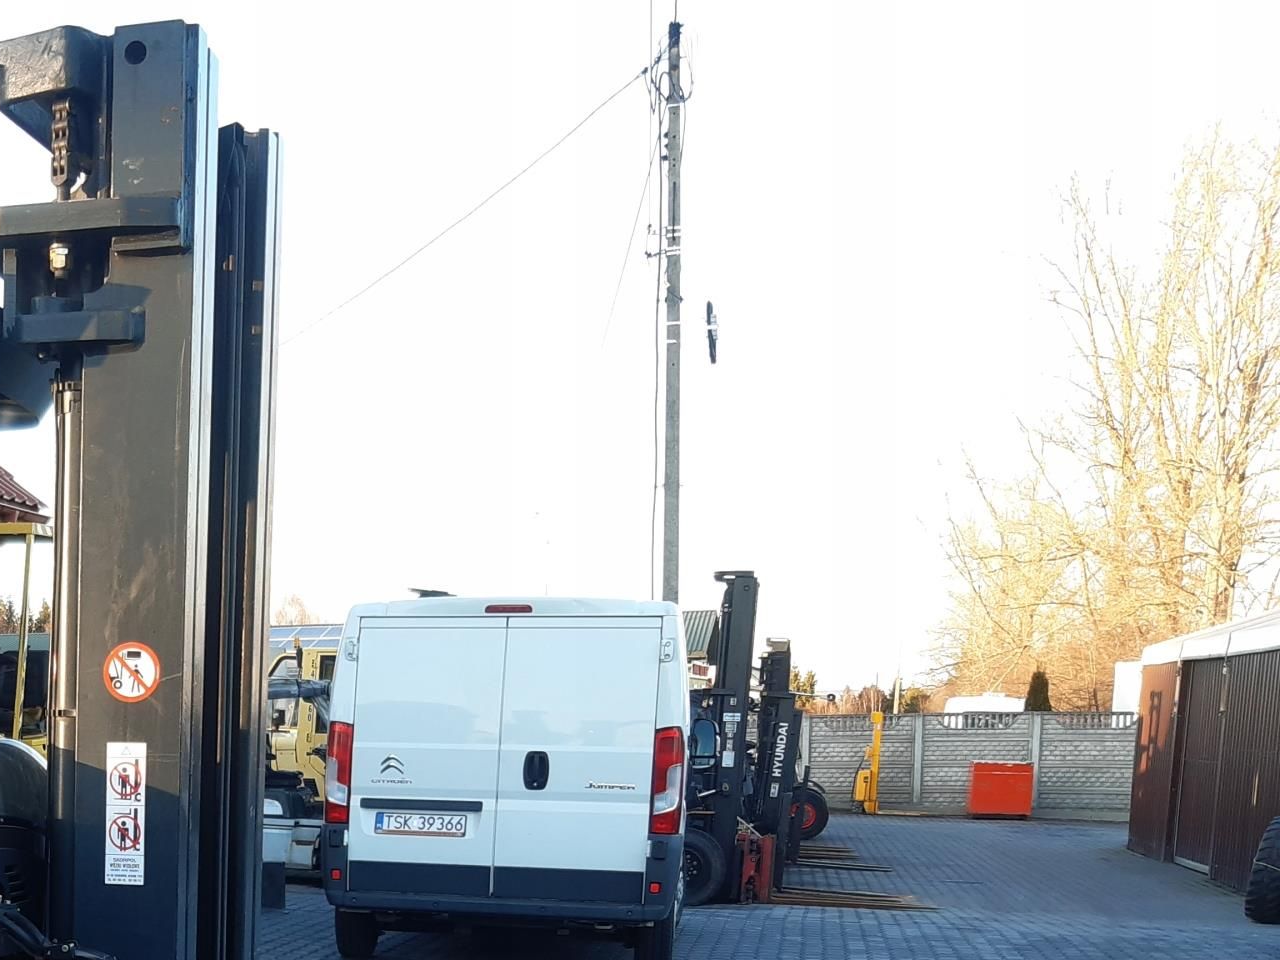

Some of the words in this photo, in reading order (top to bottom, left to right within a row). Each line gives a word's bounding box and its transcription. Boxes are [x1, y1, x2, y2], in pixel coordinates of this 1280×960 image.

[771, 722, 789, 777] HYUNDAI
[385, 815, 412, 830] TSK
[417, 816, 464, 831] 39366
